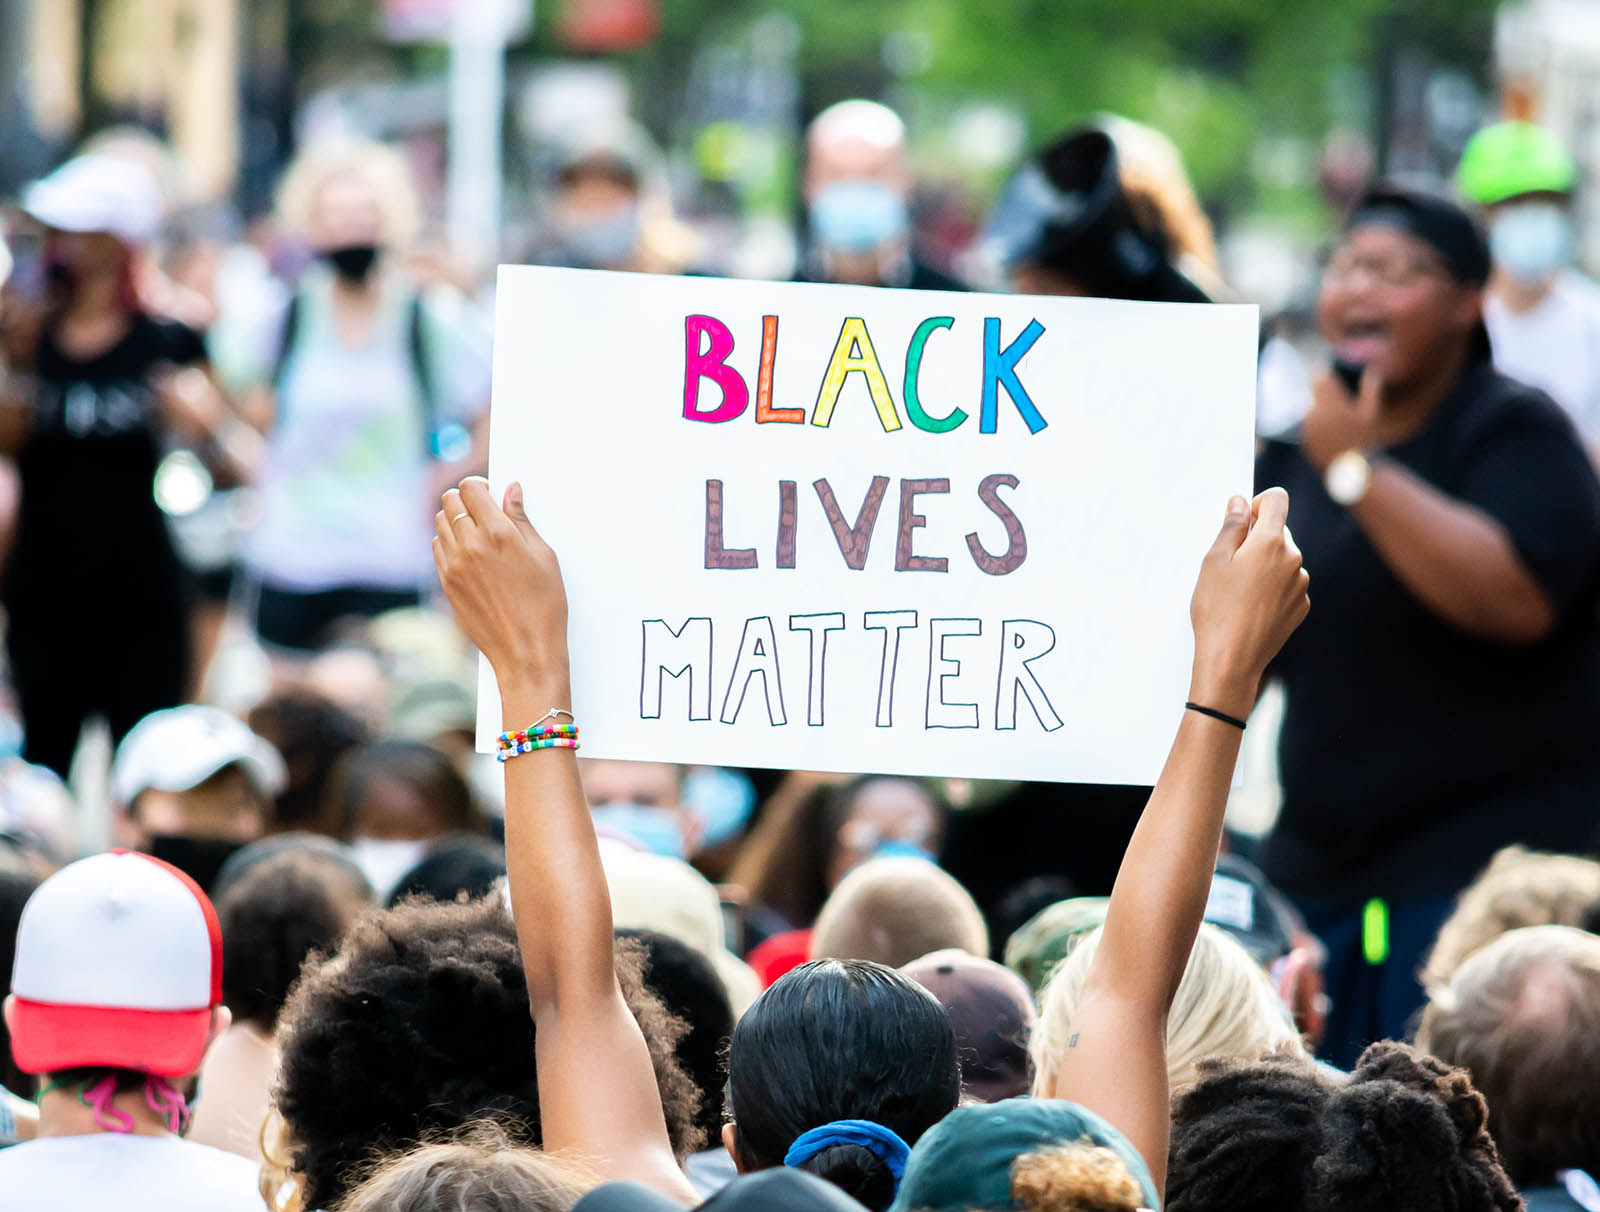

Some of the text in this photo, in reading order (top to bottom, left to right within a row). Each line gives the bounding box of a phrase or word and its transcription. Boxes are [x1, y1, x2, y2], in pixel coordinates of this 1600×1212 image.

[682, 314, 1048, 435] BLACK
[704, 474, 1027, 576] LIVES
[640, 610, 1064, 732] MATTER
